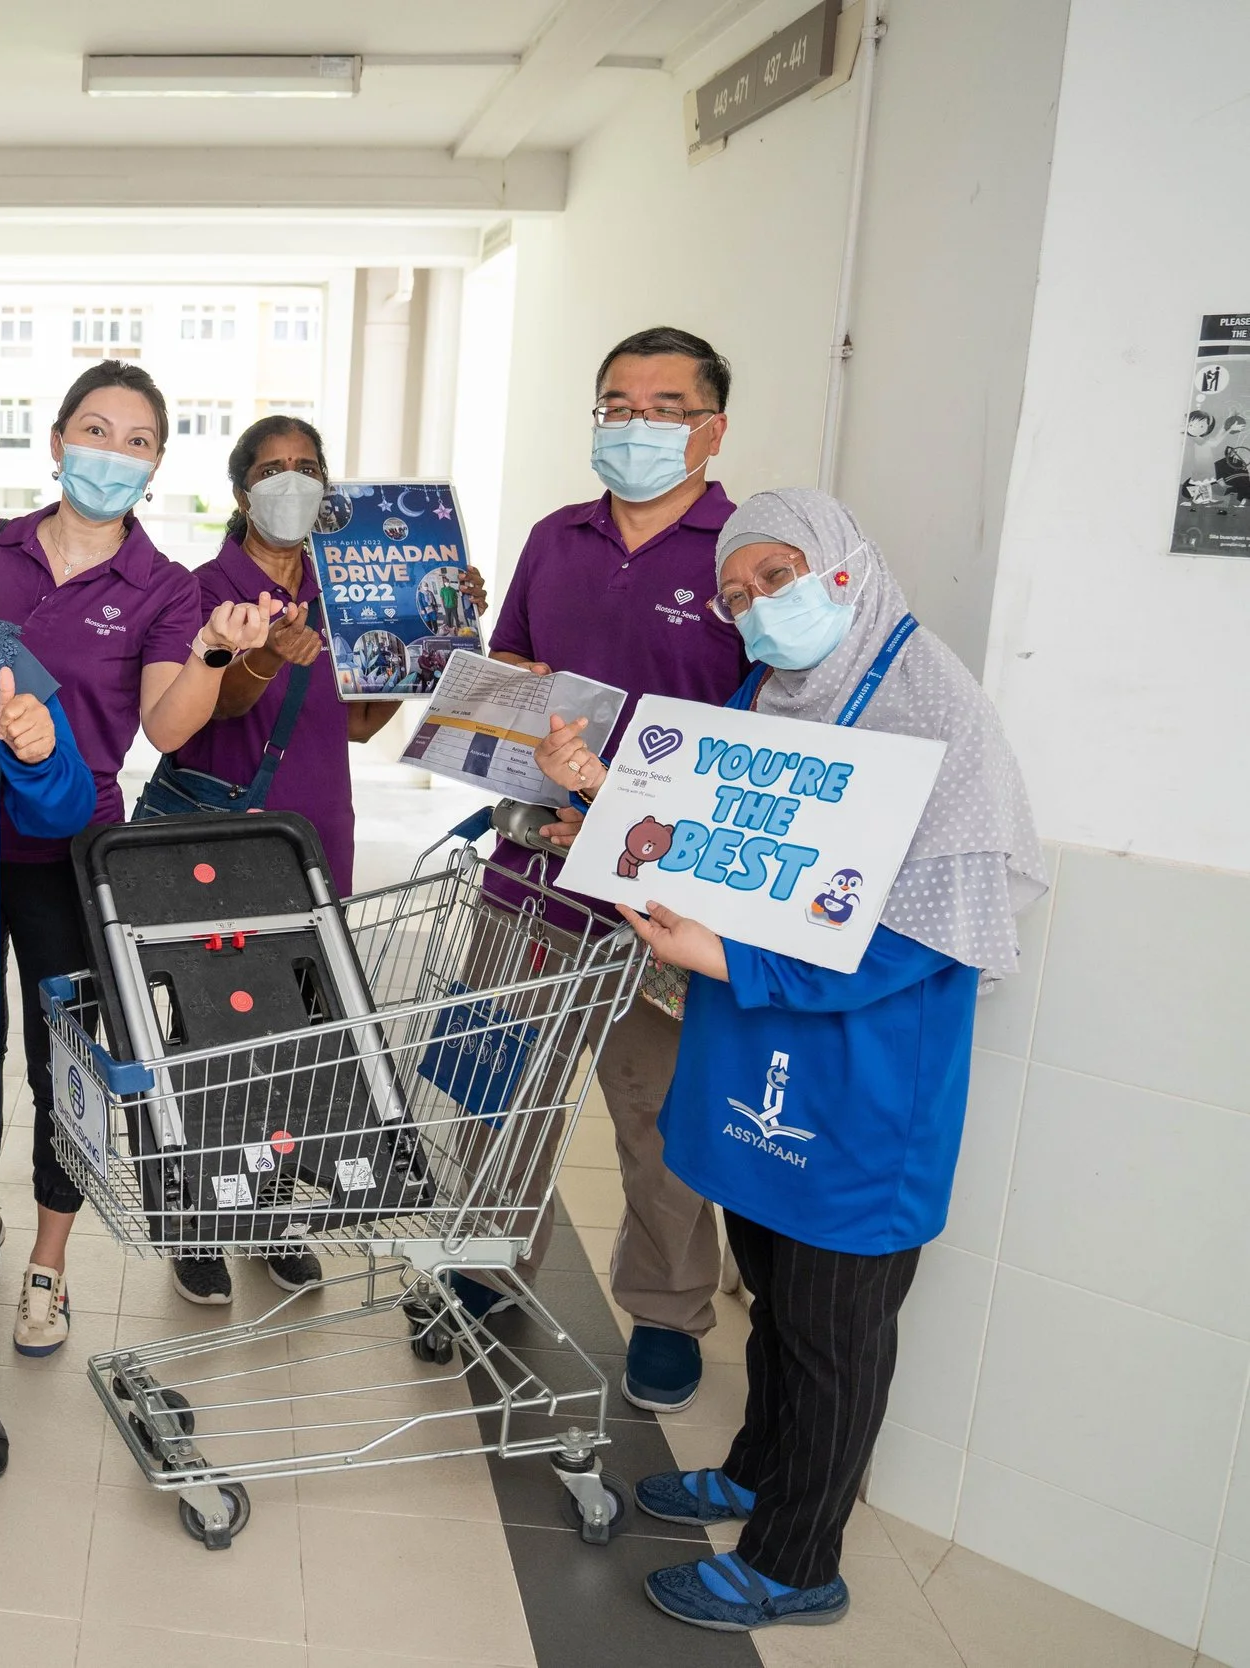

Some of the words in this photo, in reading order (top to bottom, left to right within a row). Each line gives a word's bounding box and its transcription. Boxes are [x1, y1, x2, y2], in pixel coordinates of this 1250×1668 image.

[764, 52, 781, 87] 437
[790, 35, 807, 71] 441
[734, 74, 749, 105] 471
[1220, 317, 1250, 326] PLEASE
[1231, 330, 1248, 338] THE
[324, 544, 459, 564] RAMADAN
[328, 563, 409, 583] DRIVE
[332, 584, 396, 603] 2022
[681, 610, 701, 621] Seeds
[617, 764, 648, 777] Blossom
[649, 771, 672, 783] Seeds
[694, 737, 854, 803] YOU'RE
[712, 785, 800, 836] THE
[657, 819, 819, 901] BEST
[722, 1122, 808, 1169] ASSYAFAAH
